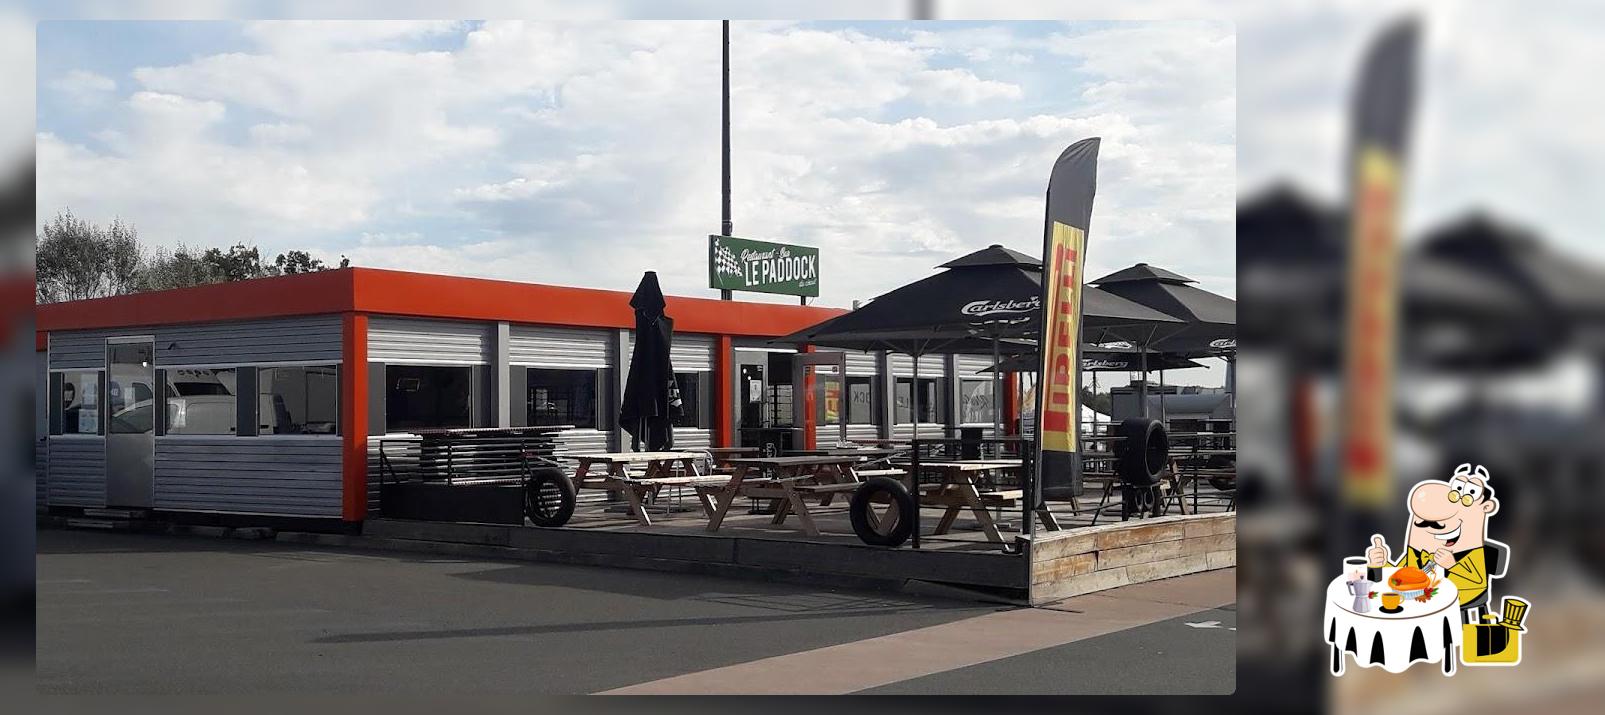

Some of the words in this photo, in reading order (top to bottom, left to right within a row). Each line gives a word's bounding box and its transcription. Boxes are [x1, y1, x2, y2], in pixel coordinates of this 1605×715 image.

[741, 248, 775, 263] Restaurant
[779, 246, 790, 258] Bar
[744, 260, 760, 287] LE
[762, 255, 816, 284] PADDOCK
[1043, 243, 1077, 432] PIRELLI
